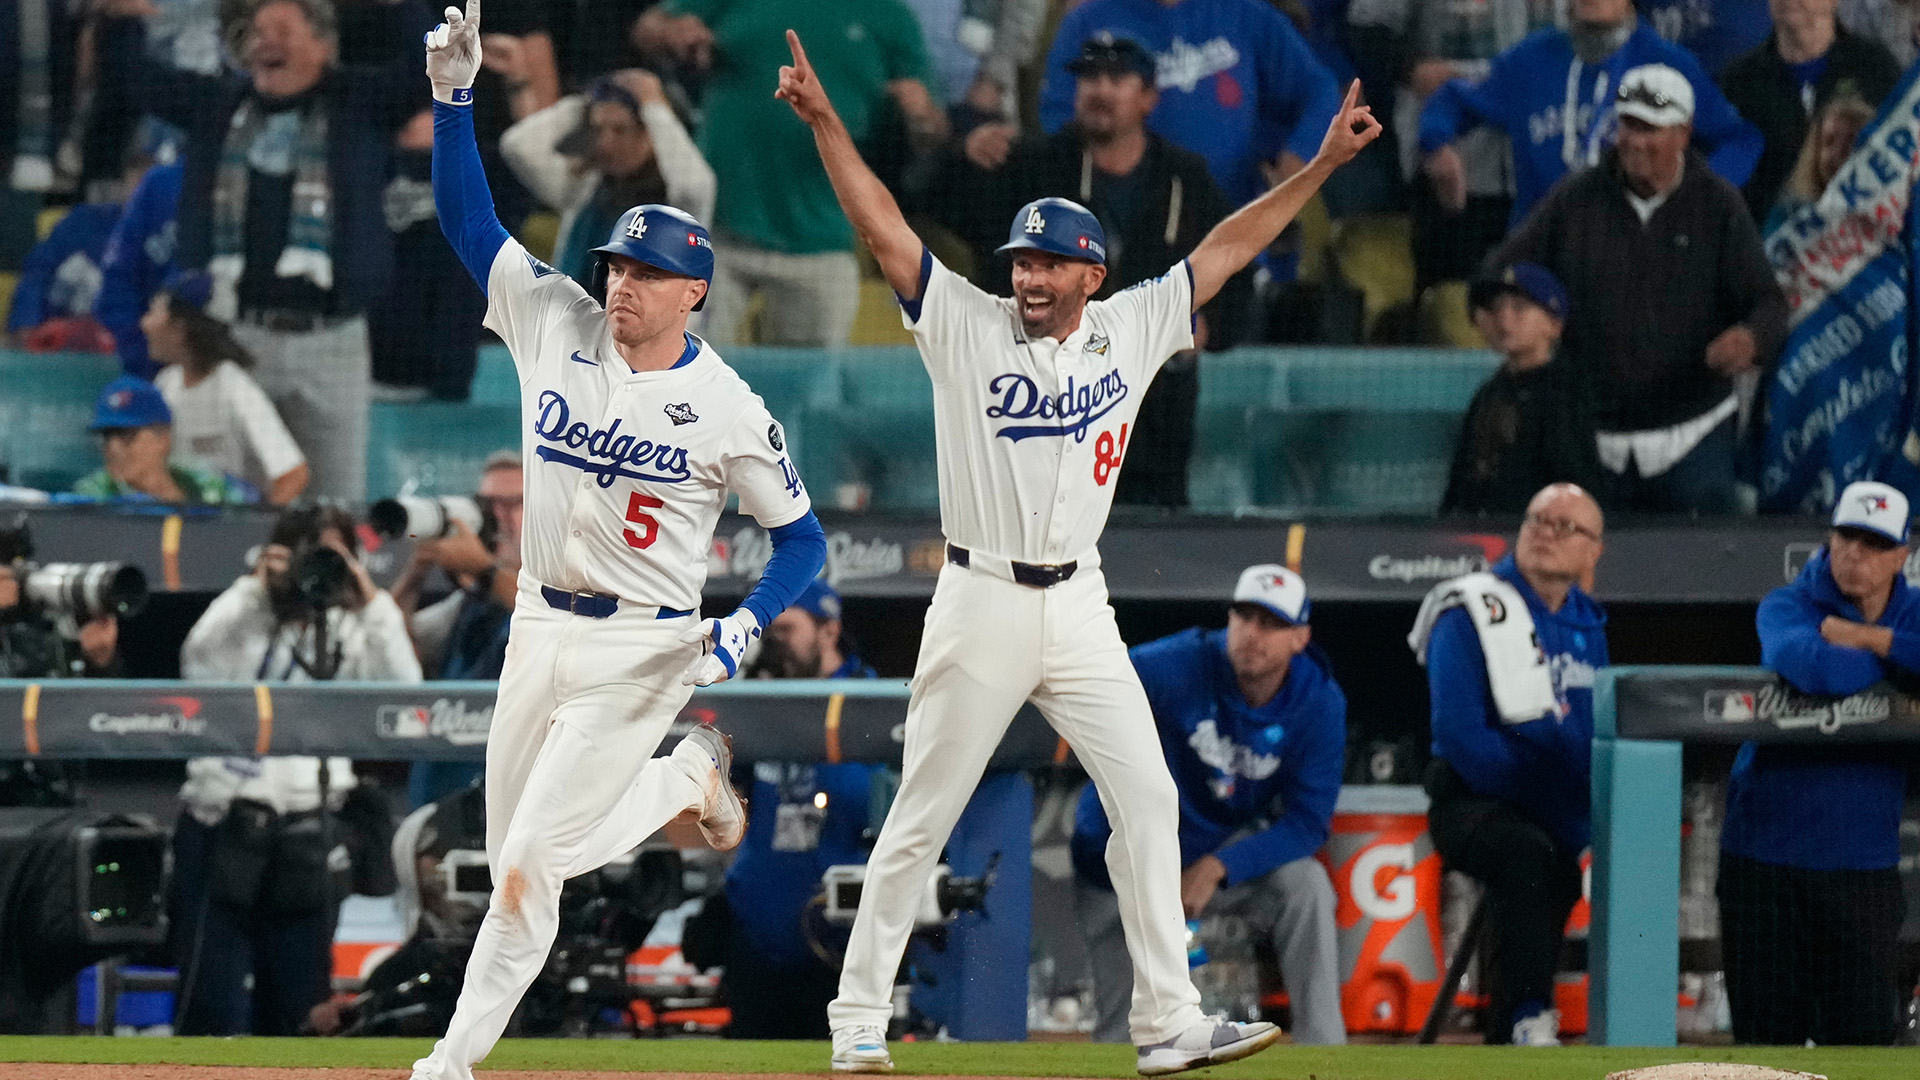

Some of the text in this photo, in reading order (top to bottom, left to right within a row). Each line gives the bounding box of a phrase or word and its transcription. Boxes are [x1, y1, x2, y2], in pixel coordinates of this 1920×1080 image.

[460, 90, 469, 101] 5
[626, 210, 648, 239] LA
[1024, 206, 1046, 234] LA
[986, 368, 1128, 444] Dodgers
[535, 389, 691, 488] Dodgers
[623, 490, 664, 550] 5
[1352, 843, 1416, 919] G
